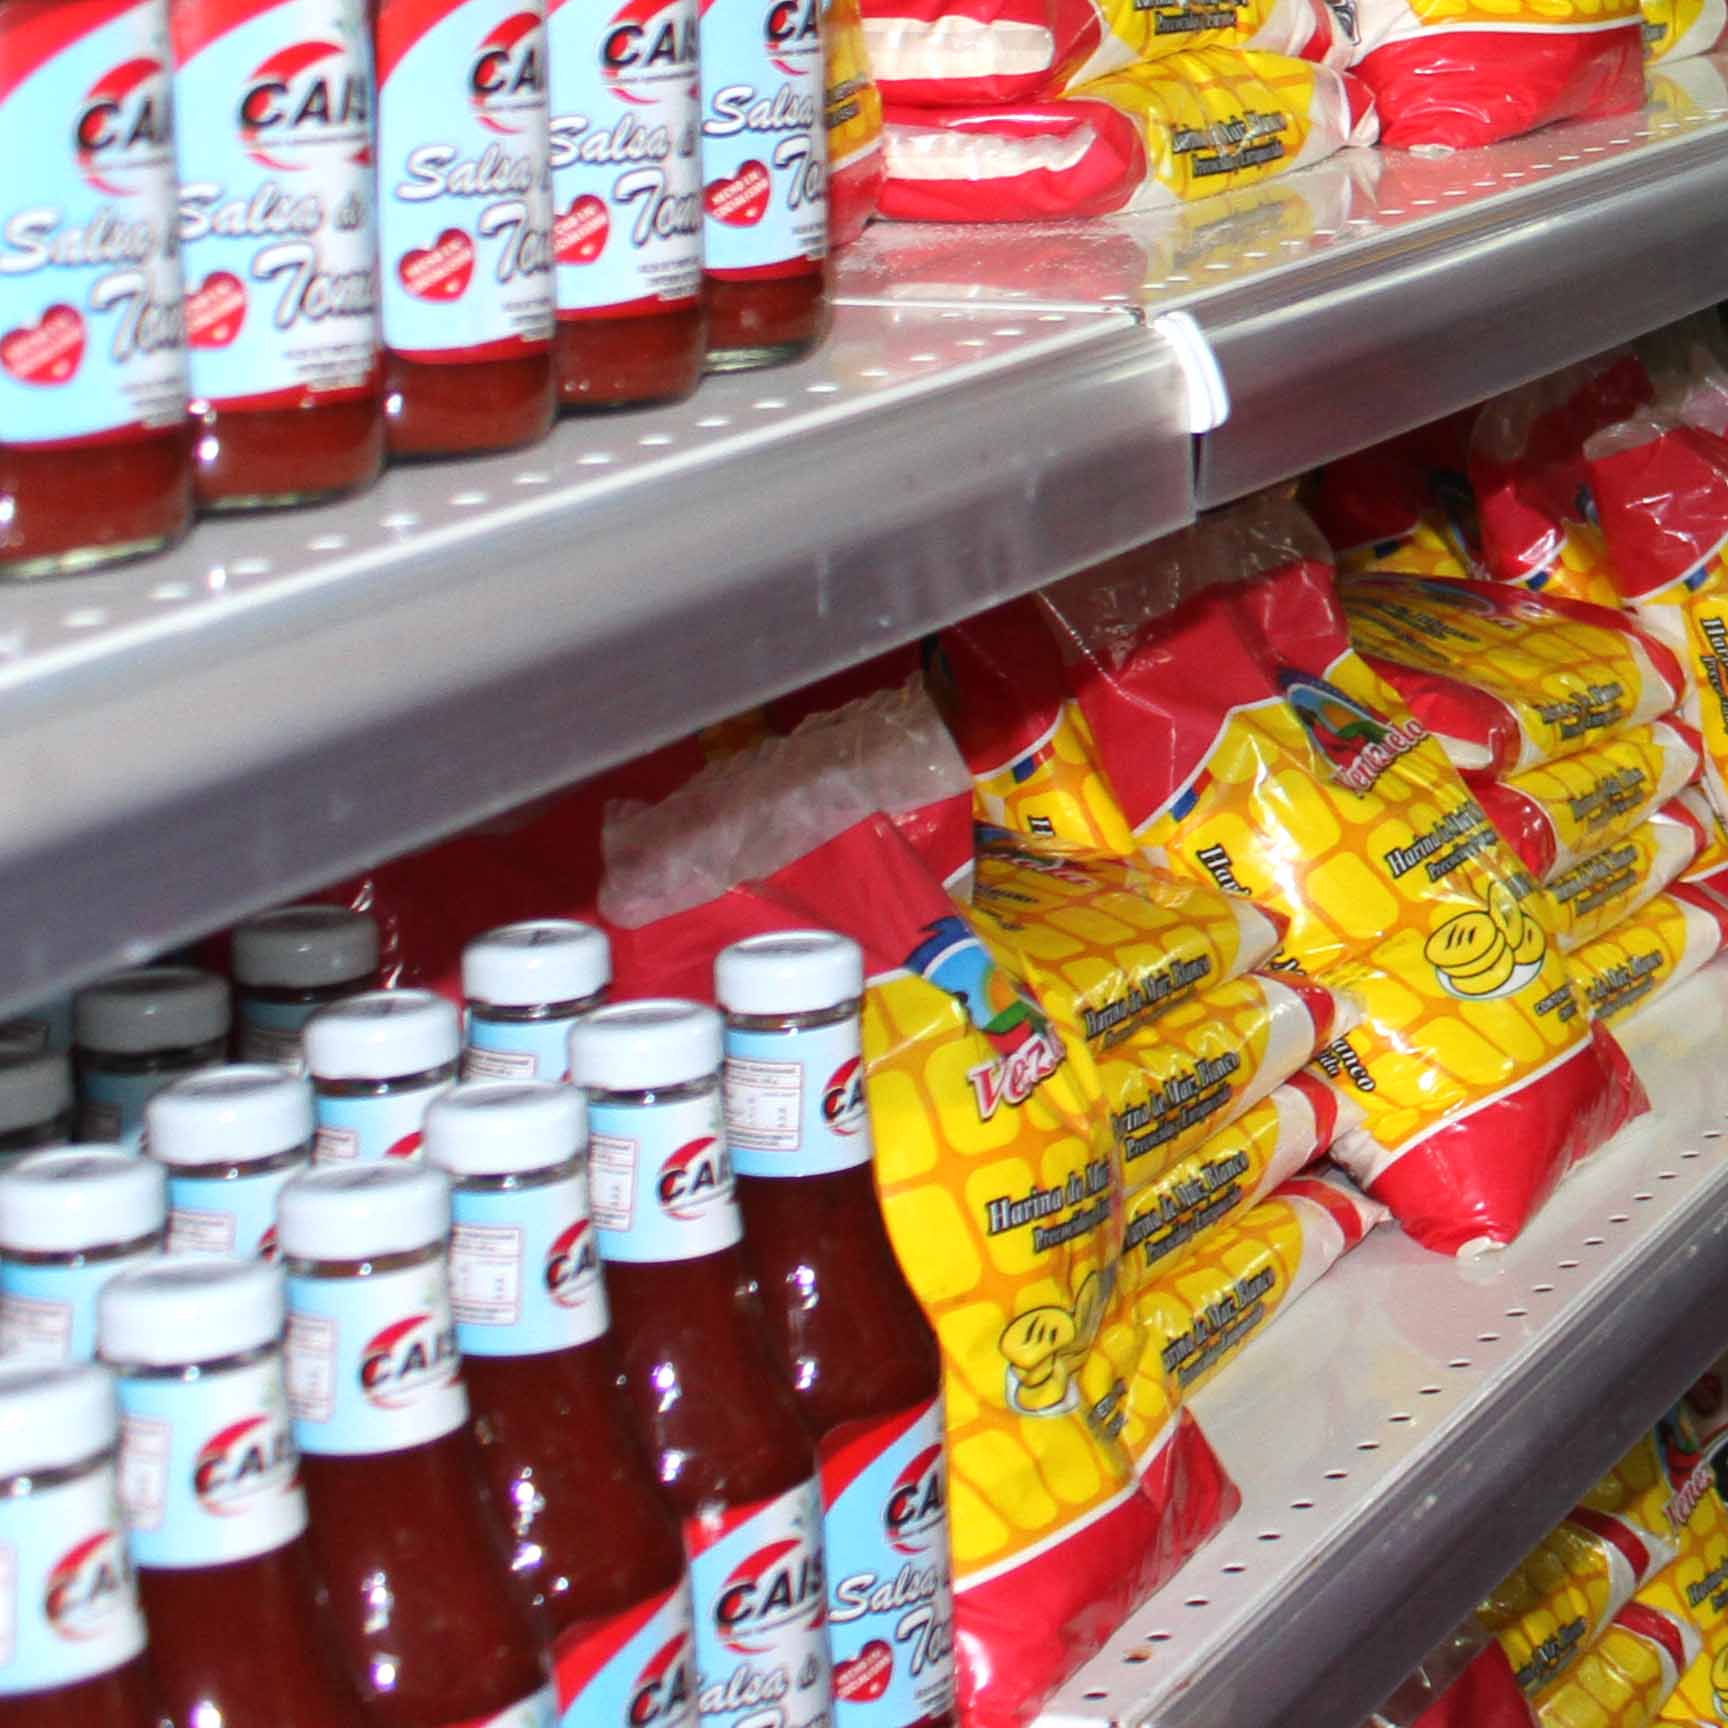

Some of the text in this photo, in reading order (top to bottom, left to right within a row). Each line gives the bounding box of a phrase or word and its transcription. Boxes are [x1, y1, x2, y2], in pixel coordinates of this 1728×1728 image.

[703, 82, 817, 138] Salsa
[549, 113, 673, 170] Salsa
[395, 142, 531, 202] Salsa
[987, 1184, 1063, 1239] Harina
[1062, 1168, 1087, 1204] de
[828, 1561, 937, 1623] Salsa
